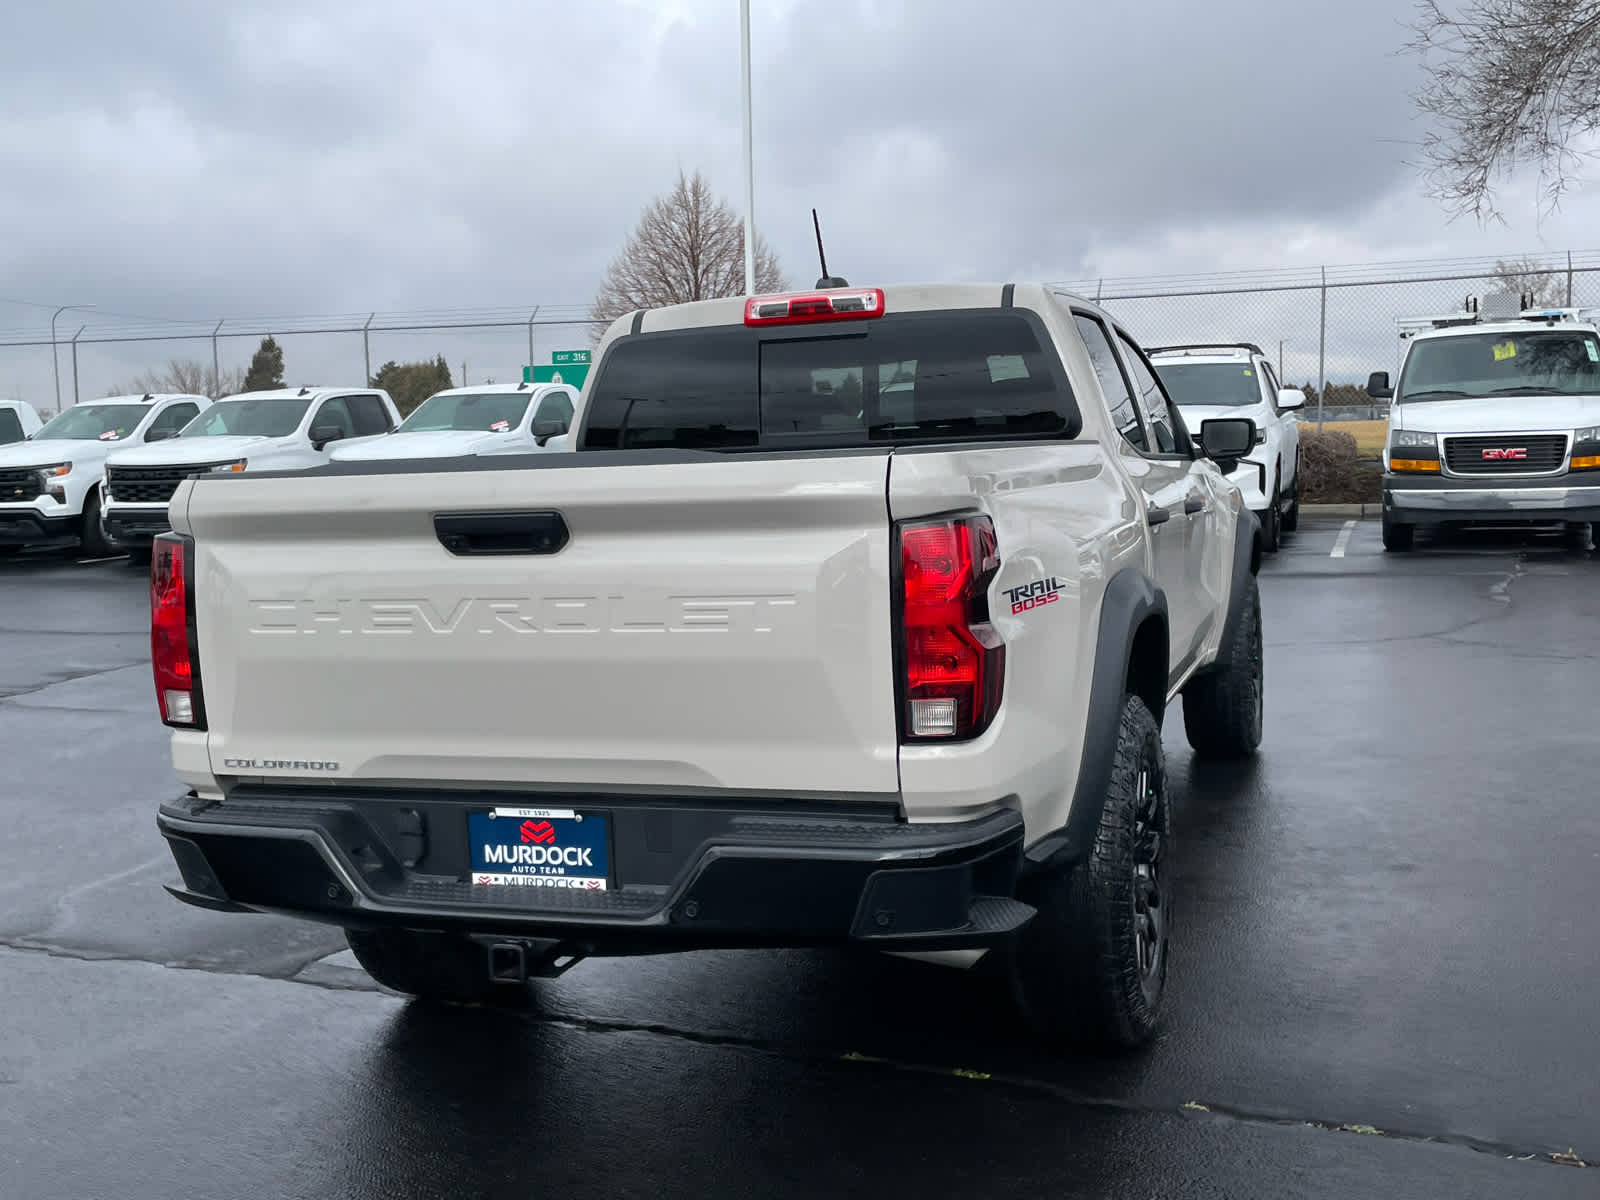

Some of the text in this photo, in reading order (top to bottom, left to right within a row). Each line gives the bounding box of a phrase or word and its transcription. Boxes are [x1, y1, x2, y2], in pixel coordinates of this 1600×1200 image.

[573, 352, 587, 361] 316
[1482, 448, 1528, 460] GMC
[1002, 576, 1066, 603] TRAIL
[1011, 590, 1059, 616] BOSS
[248, 594, 797, 635] CHEVROLET
[224, 758, 339, 771] COLORADO
[484, 844, 593, 867] MURDOCK
[512, 865, 565, 875] AUTO TEAM
[503, 876, 576, 890] MURDOCK
